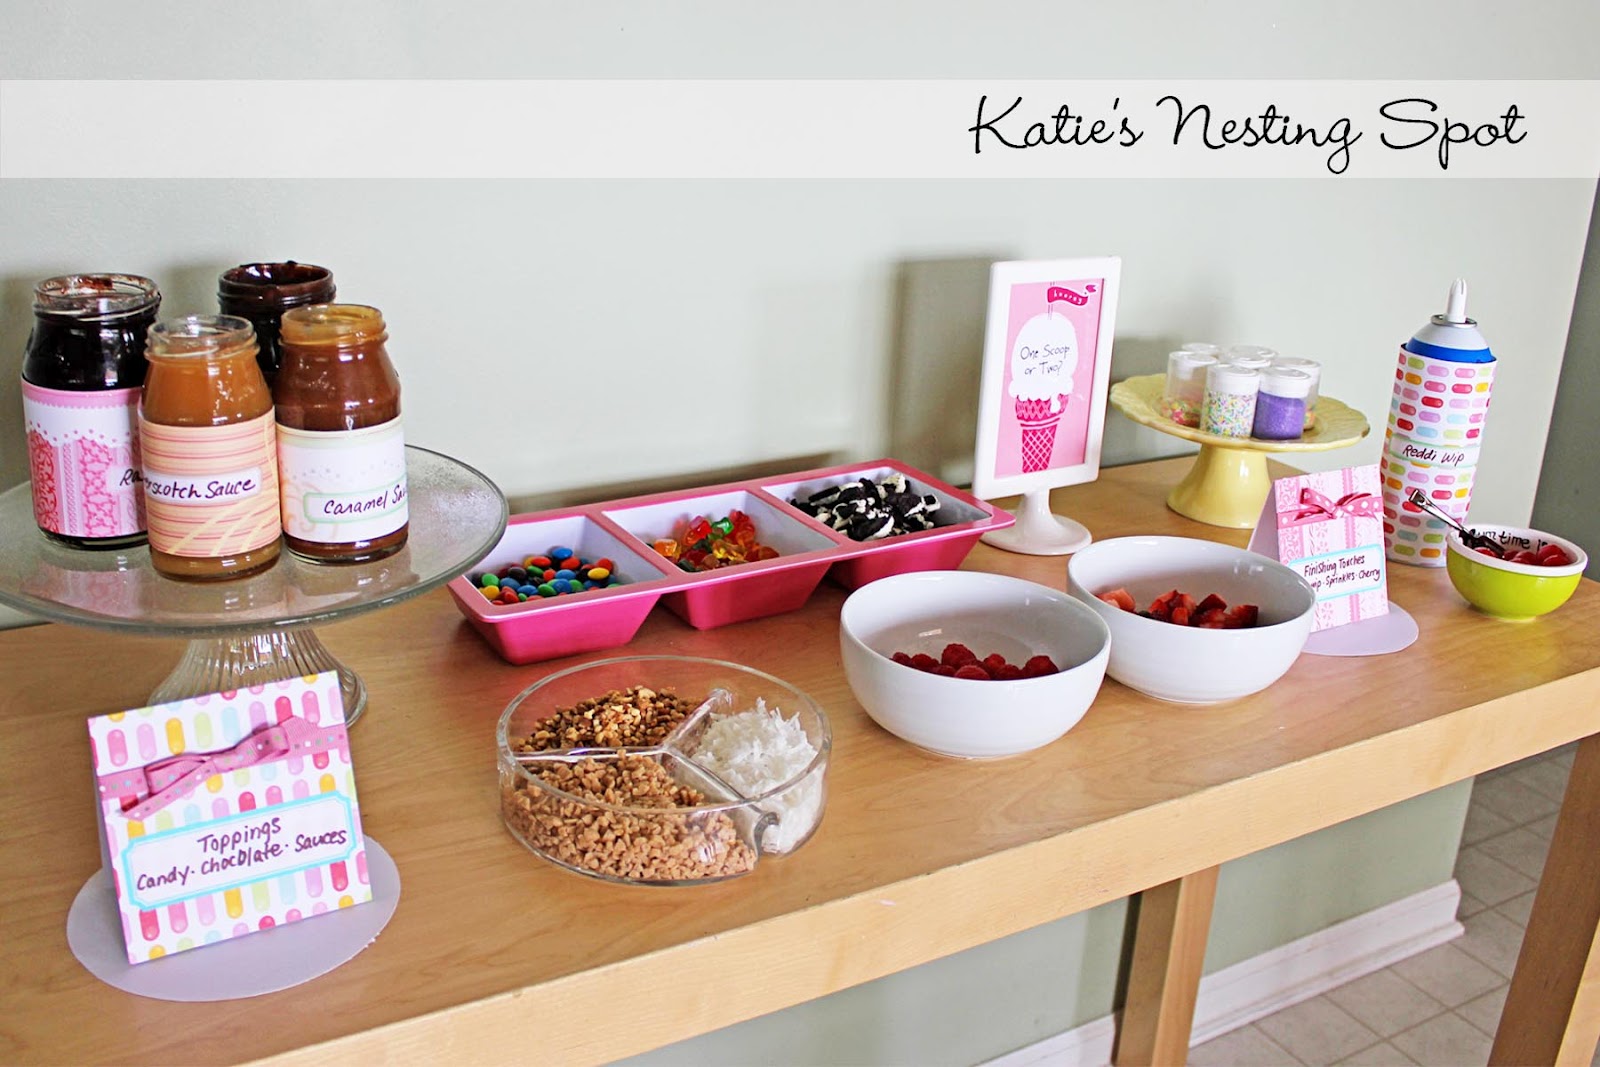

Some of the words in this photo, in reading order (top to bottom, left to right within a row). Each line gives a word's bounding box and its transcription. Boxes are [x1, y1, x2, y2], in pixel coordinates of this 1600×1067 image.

[1020, 346, 1039, 360] One
[1042, 344, 1071, 359] Scoop
[1024, 366, 1036, 375] or
[1403, 444, 1437, 461] Reddi
[204, 478, 256, 499] Sauce
[1498, 531, 1530, 549] time
[1339, 555, 1366, 569] Touches
[197, 817, 282, 853] Toppings
[295, 829, 347, 852] Sauces
